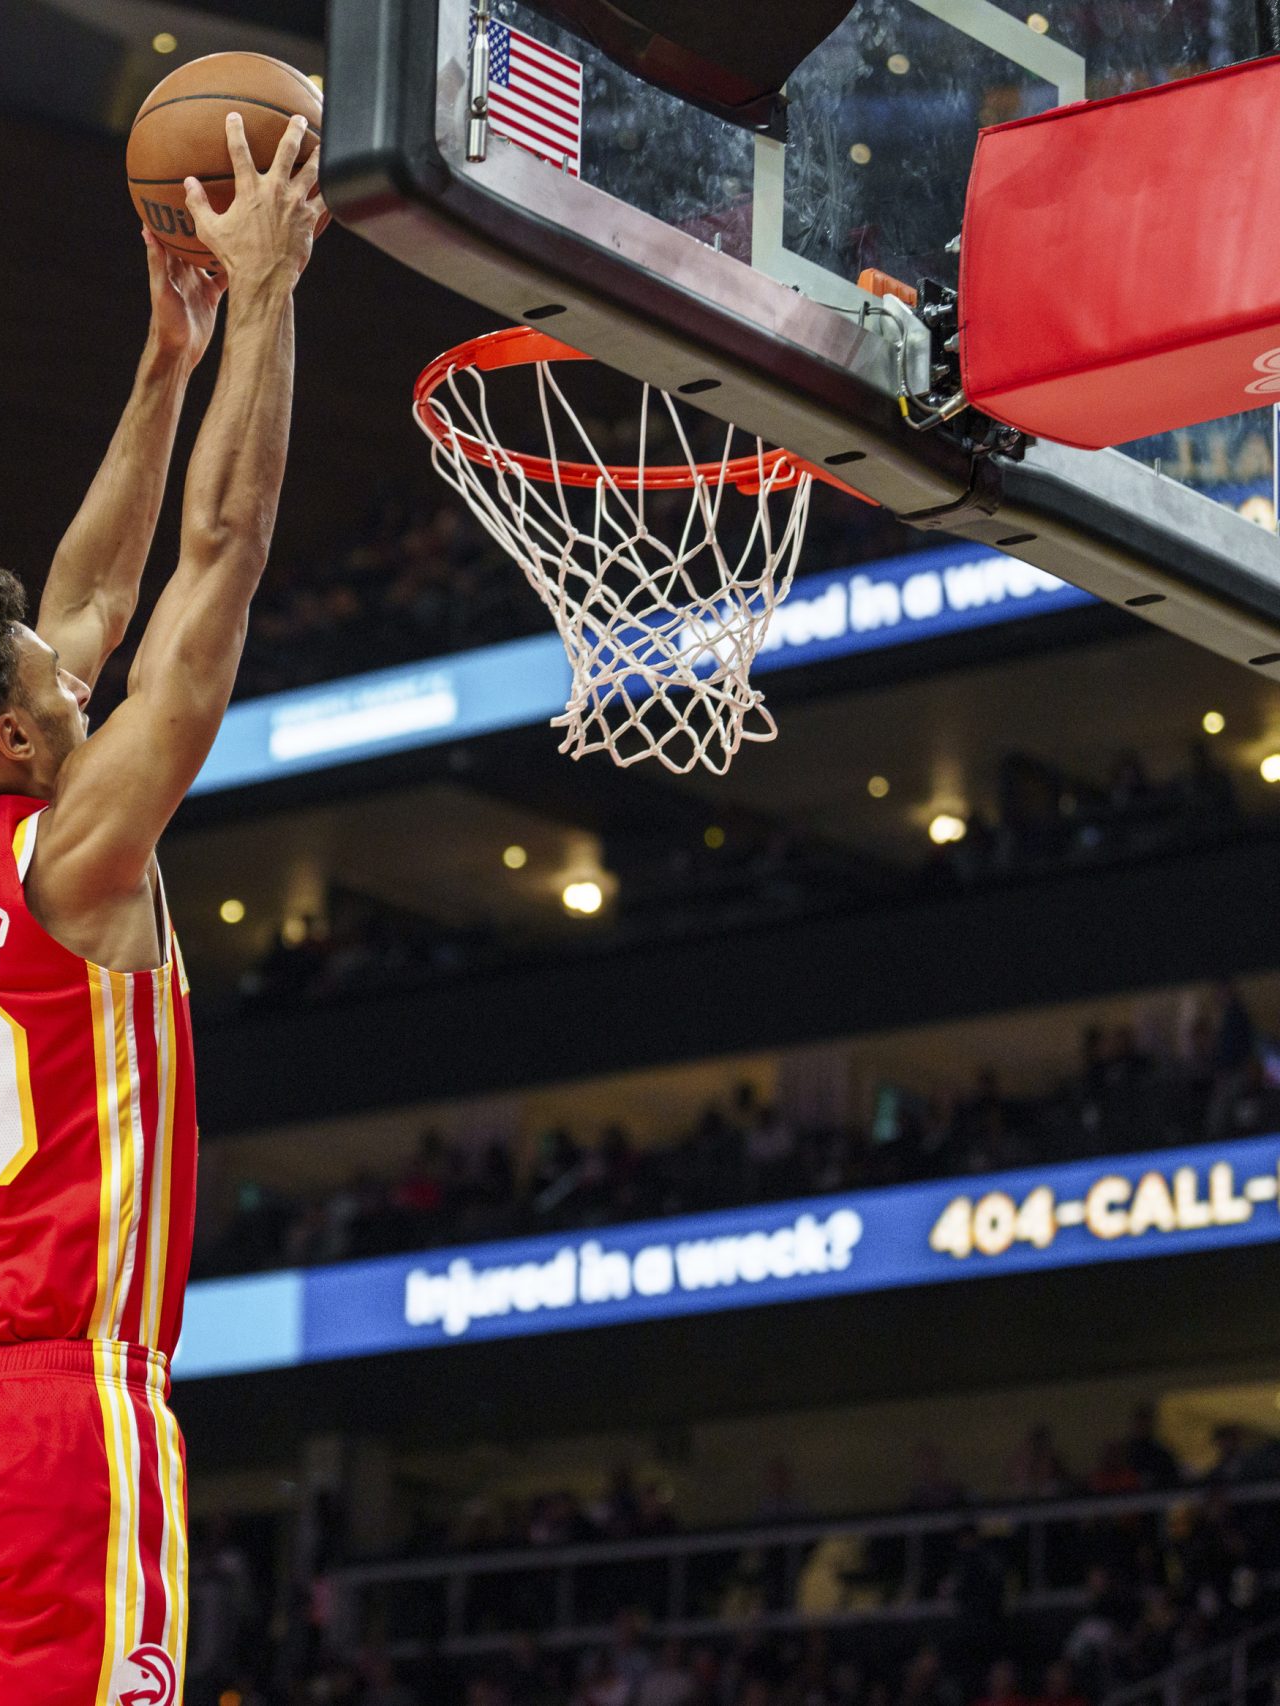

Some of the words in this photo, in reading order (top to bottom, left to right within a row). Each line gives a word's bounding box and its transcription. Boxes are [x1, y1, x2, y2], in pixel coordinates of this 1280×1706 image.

[577, 1219, 633, 1304] in
[631, 1244, 675, 1298] a
[674, 1208, 864, 1291] wreck?
[928, 1160, 1280, 1260] 404-CALL-
